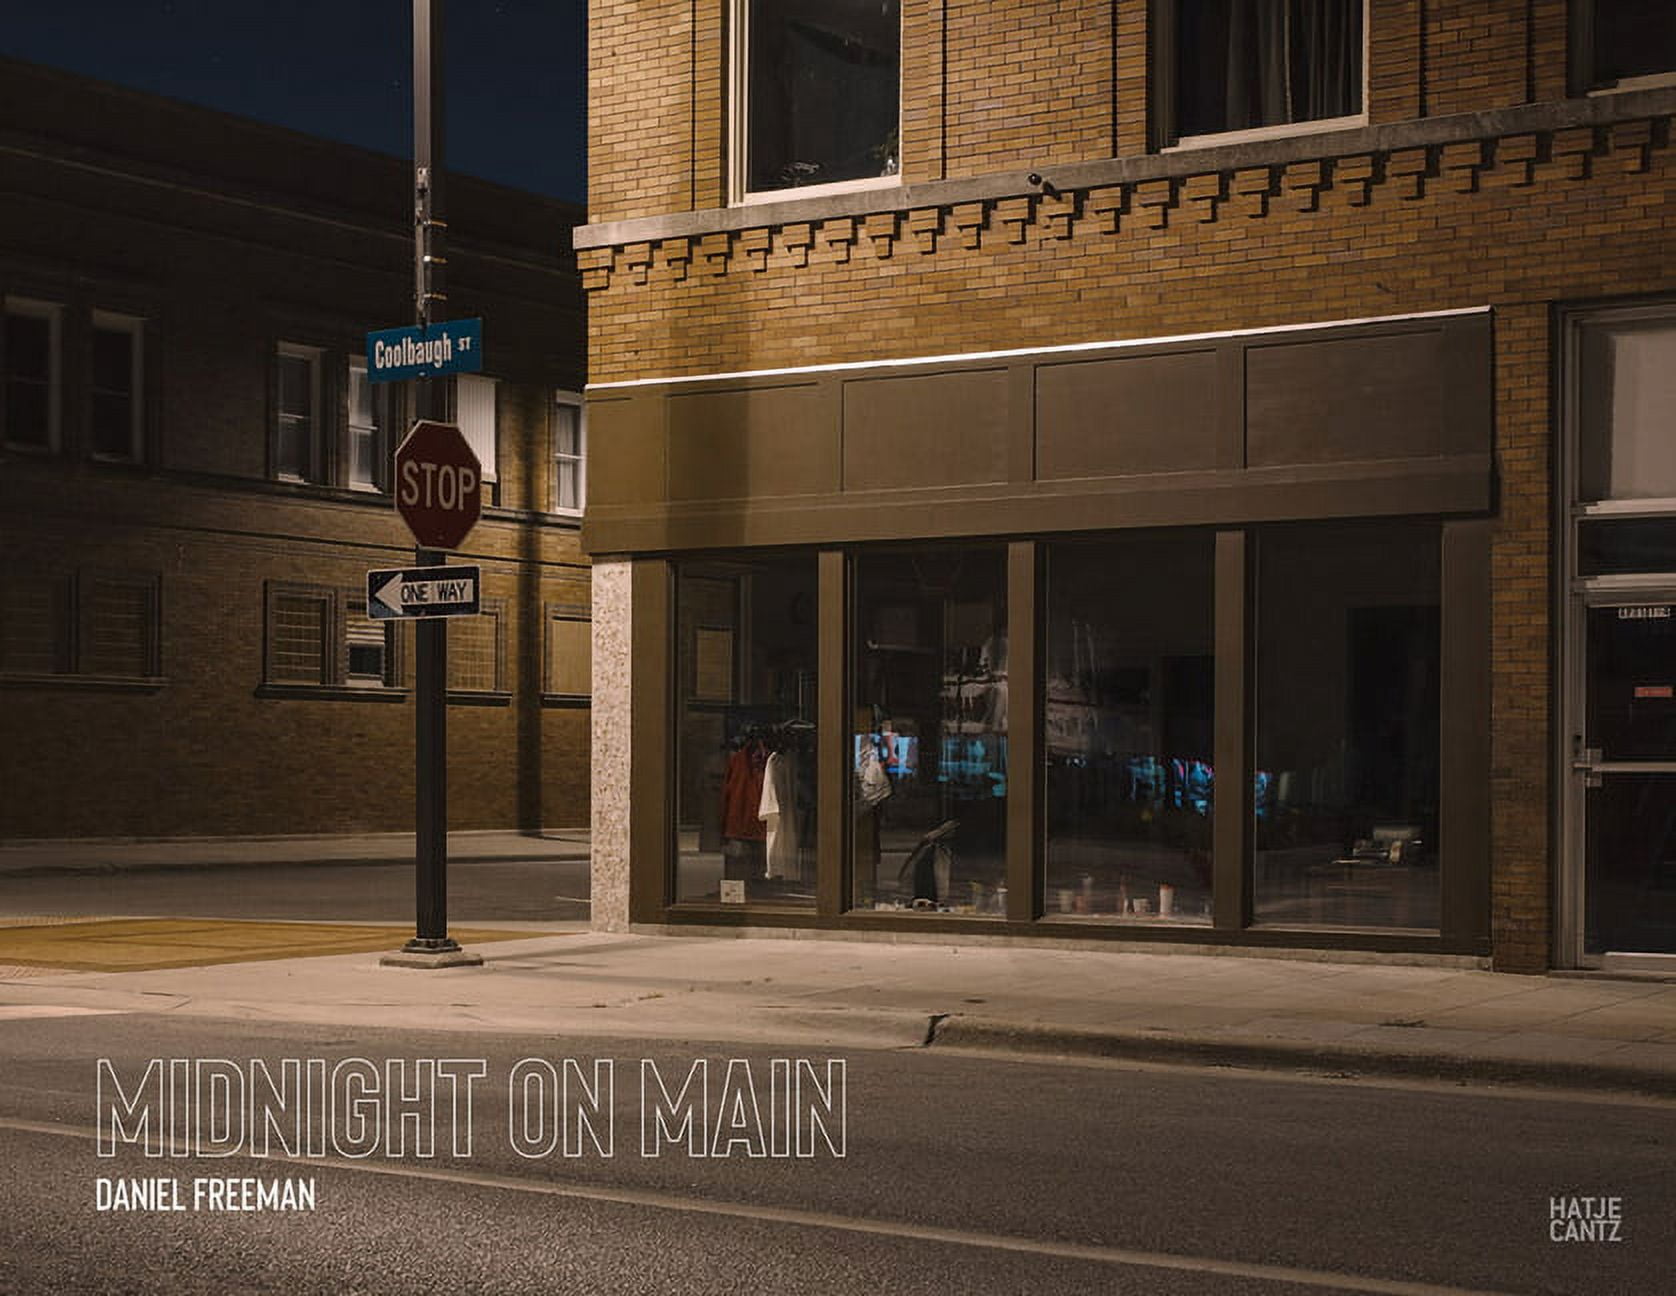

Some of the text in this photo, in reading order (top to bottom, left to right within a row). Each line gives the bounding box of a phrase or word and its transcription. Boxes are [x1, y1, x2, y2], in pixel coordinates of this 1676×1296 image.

[375, 331, 471, 369] Coolbaugh ST
[401, 459, 476, 512] STOP
[401, 581, 467, 603] ONE WAY
